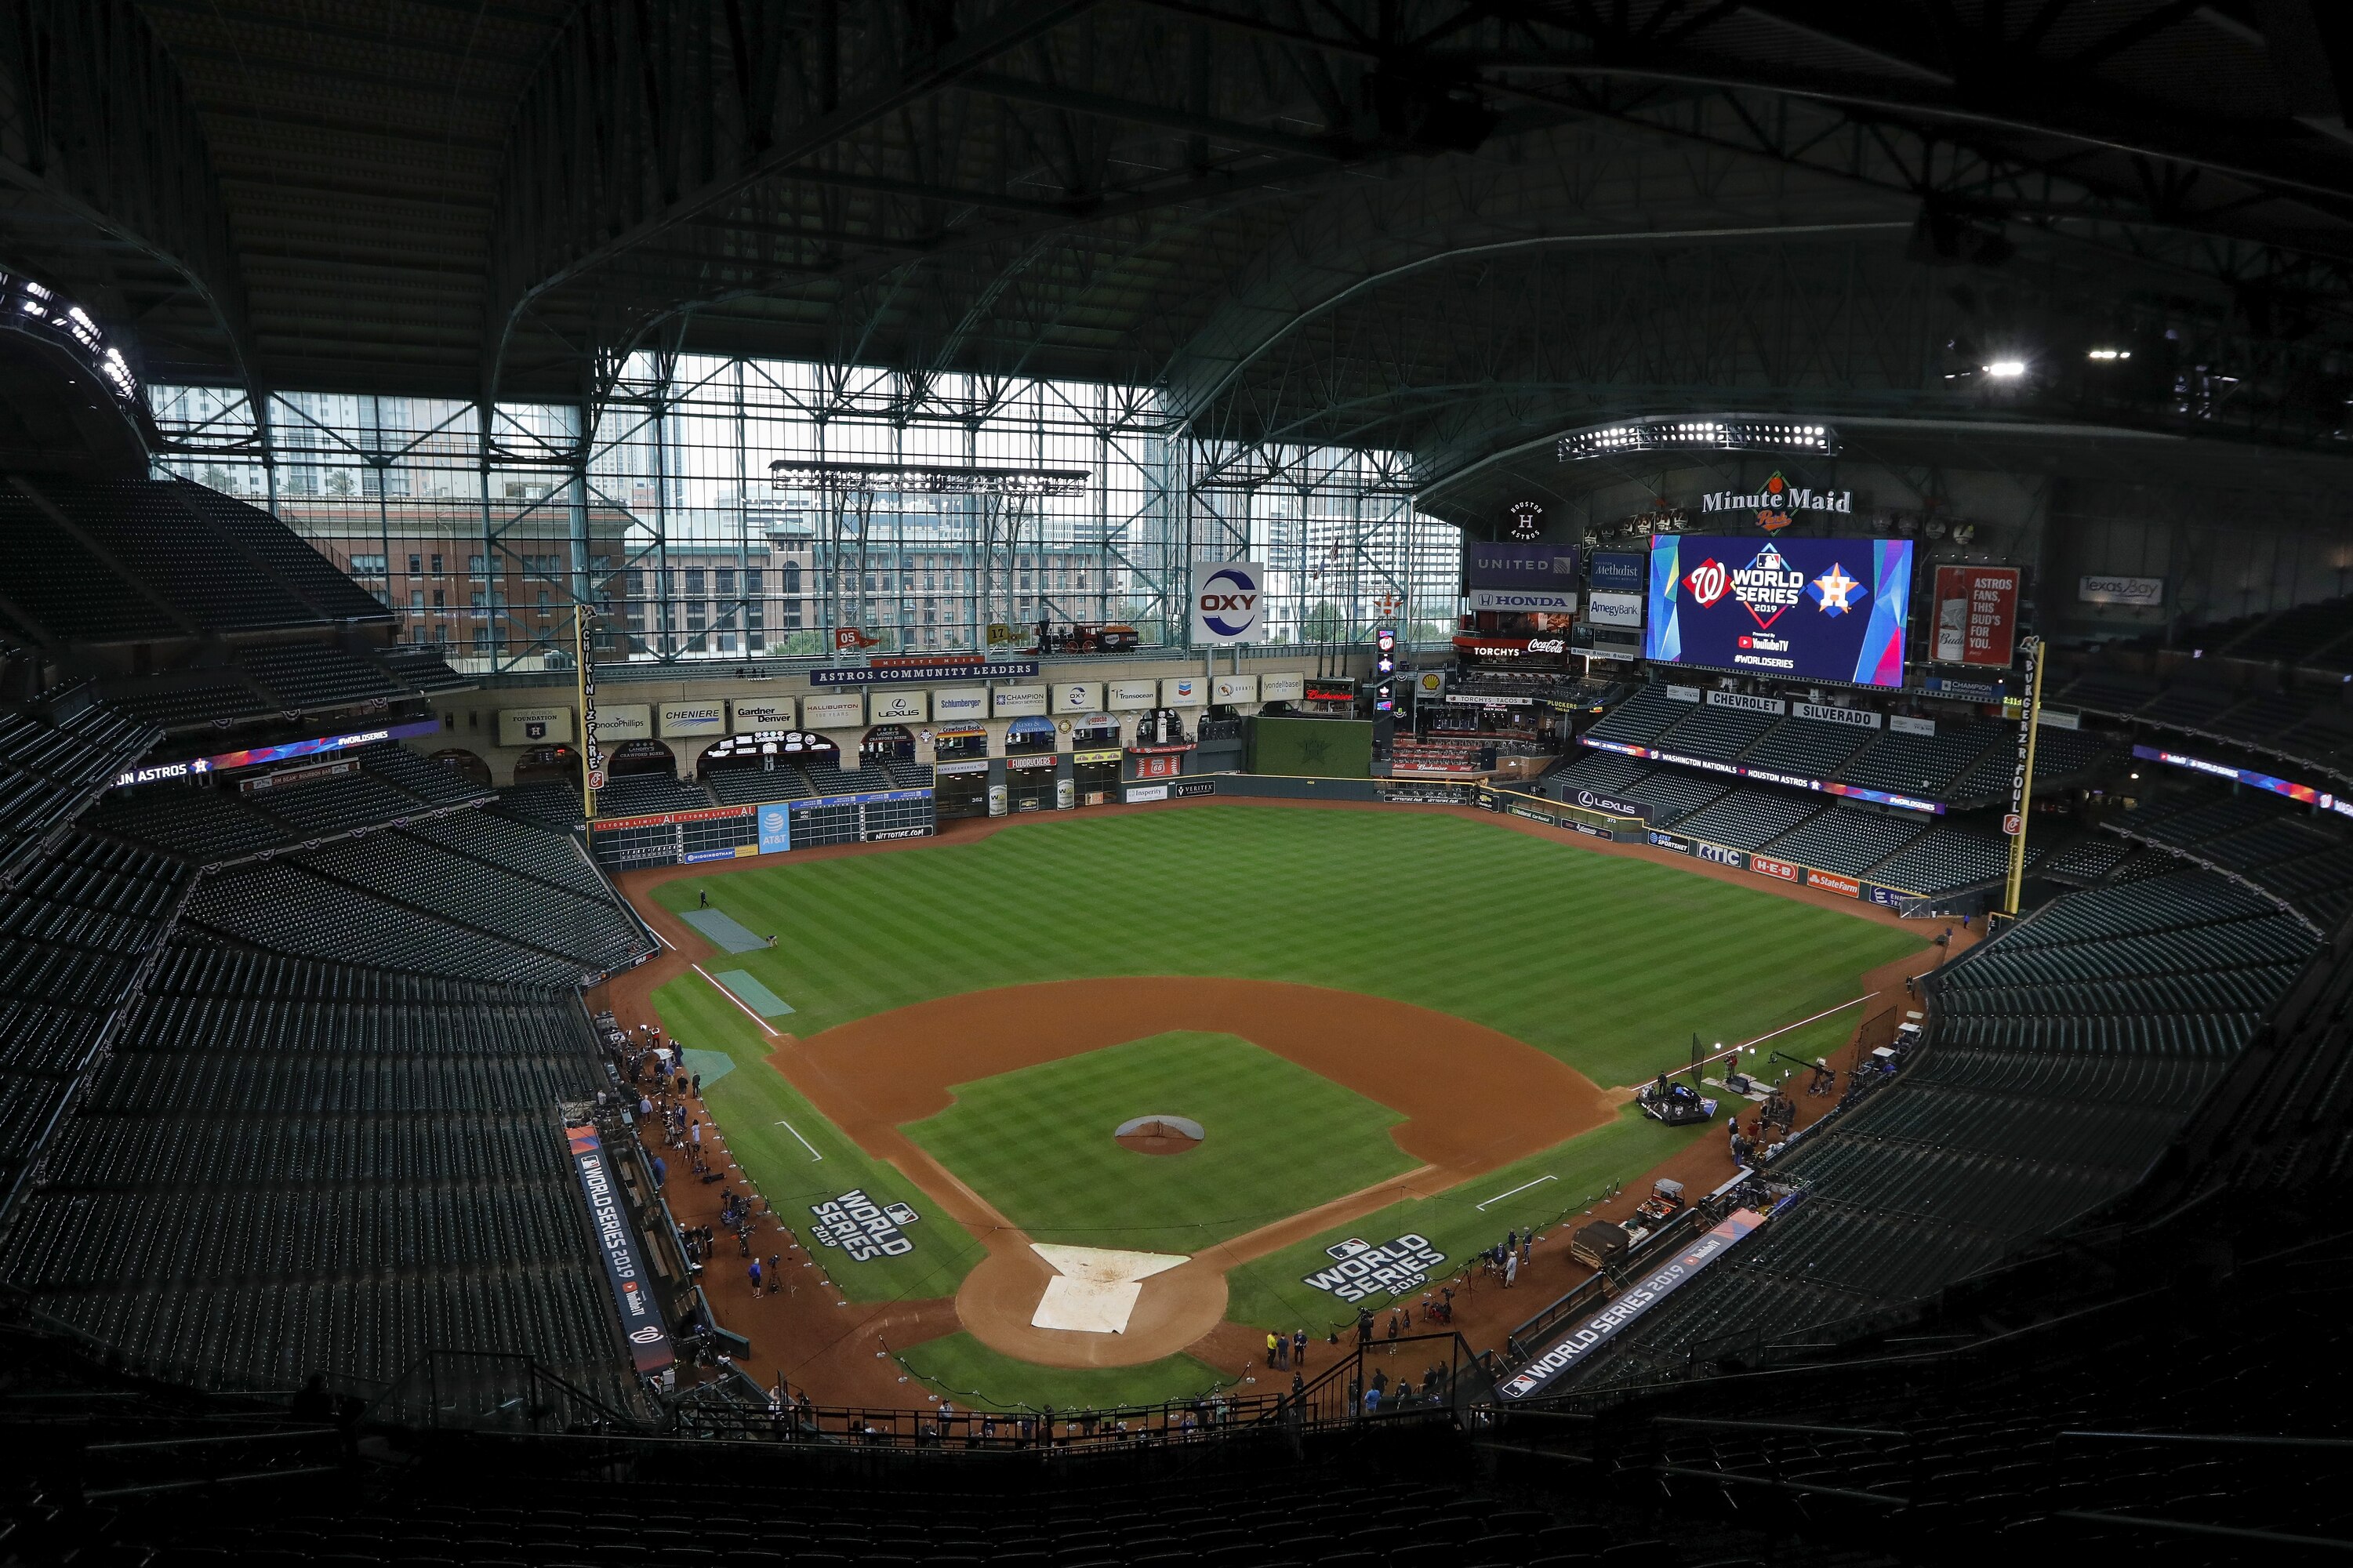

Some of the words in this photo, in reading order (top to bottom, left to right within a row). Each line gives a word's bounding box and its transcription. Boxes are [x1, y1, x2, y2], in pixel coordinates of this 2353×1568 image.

[1702, 491, 1784, 513] Minute
[1788, 488, 1852, 514] Maid
[1510, 501, 1543, 514] HOUSTON
[1756, 510, 1792, 530] Park
[1511, 529, 1540, 540] ASTROS
[1478, 559, 1549, 570] UNITED
[1595, 564, 1638, 576] Methodist
[1732, 569, 1804, 589] WORLD
[1974, 578, 2012, 590] ASTROS
[2086, 578, 2122, 592] Texas
[2121, 579, 2158, 597] Bay
[1496, 596, 1568, 607] HONDA
[1735, 587, 1799, 604] SERIES
[1974, 590, 2001, 602] FANS,
[1200, 594, 1258, 611] OXY
[1755, 604, 1777, 613] 2019
[1973, 602, 1995, 613] THIS
[1971, 614, 2001, 625] BUD'S
[841, 632, 855, 643] 05
[992, 628, 1004, 638] 17
[1970, 626, 1989, 637] FOR
[1970, 637, 1992, 649] YOU.
[1474, 648, 1520, 656] TORCHYS
[1734, 655, 1794, 670] #WORLDSERIES
[881, 667, 968, 679] COMMUNITY
[974, 665, 1031, 675] LEADERS
[1952, 681, 1992, 691] CHAMPION
[1305, 688, 1353, 700] Budweiser
[941, 699, 981, 708] Schlumberger
[1548, 700, 1578, 710] PLUCKERS
[1714, 693, 1778, 712] CHEVROLET
[1803, 706, 1872, 725] SILVERADO
[666, 710, 719, 720] CHENIERE
[738, 707, 775, 717] Gardner
[597, 718, 644, 729] onocoPhillips
[338, 730, 388, 746] #WORLDSERIES
[1013, 757, 1051, 768] FUDDRUCKERS
[137, 763, 187, 783] ASTROS
[299, 771, 321, 779] BOURBON
[1662, 753, 1701, 767] WASHINGTON
[1702, 761, 1738, 774] NATIONALS
[1748, 769, 1780, 782] HOUSTON
[1781, 775, 1808, 787] ASTROS
[2012, 764, 2025, 813] FOUL
[1595, 798, 1636, 815] LEXUS
[1890, 797, 1935, 811] #WORLDSERIES
[1516, 809, 1531, 818] National
[763, 834, 786, 846] AT&T
[875, 829, 924, 840] NITTOTIRE.COM
[1658, 840, 1688, 851] SPORTSNET
[694, 851, 733, 860] HIGGINBOTHAM
[1698, 844, 1740, 866] RTIC
[1757, 860, 1792, 877] H-E-B
[585, 1167, 612, 1207] WORLD
[596, 1207, 626, 1249] SERIES
[837, 1189, 912, 1255] WORLD
[812, 1202, 881, 1261] SERIES
[812, 1225, 837, 1247] 2019
[611, 1249, 635, 1279] 2019
[1304, 1234, 1429, 1290] WORLD
[1334, 1248, 1445, 1302] SERIES
[1387, 1273, 1425, 1295] 2019
[1525, 1329, 1600, 1379] WORLD
[1593, 1288, 1654, 1333] SERIES
[1647, 1265, 1685, 1292] 2019
